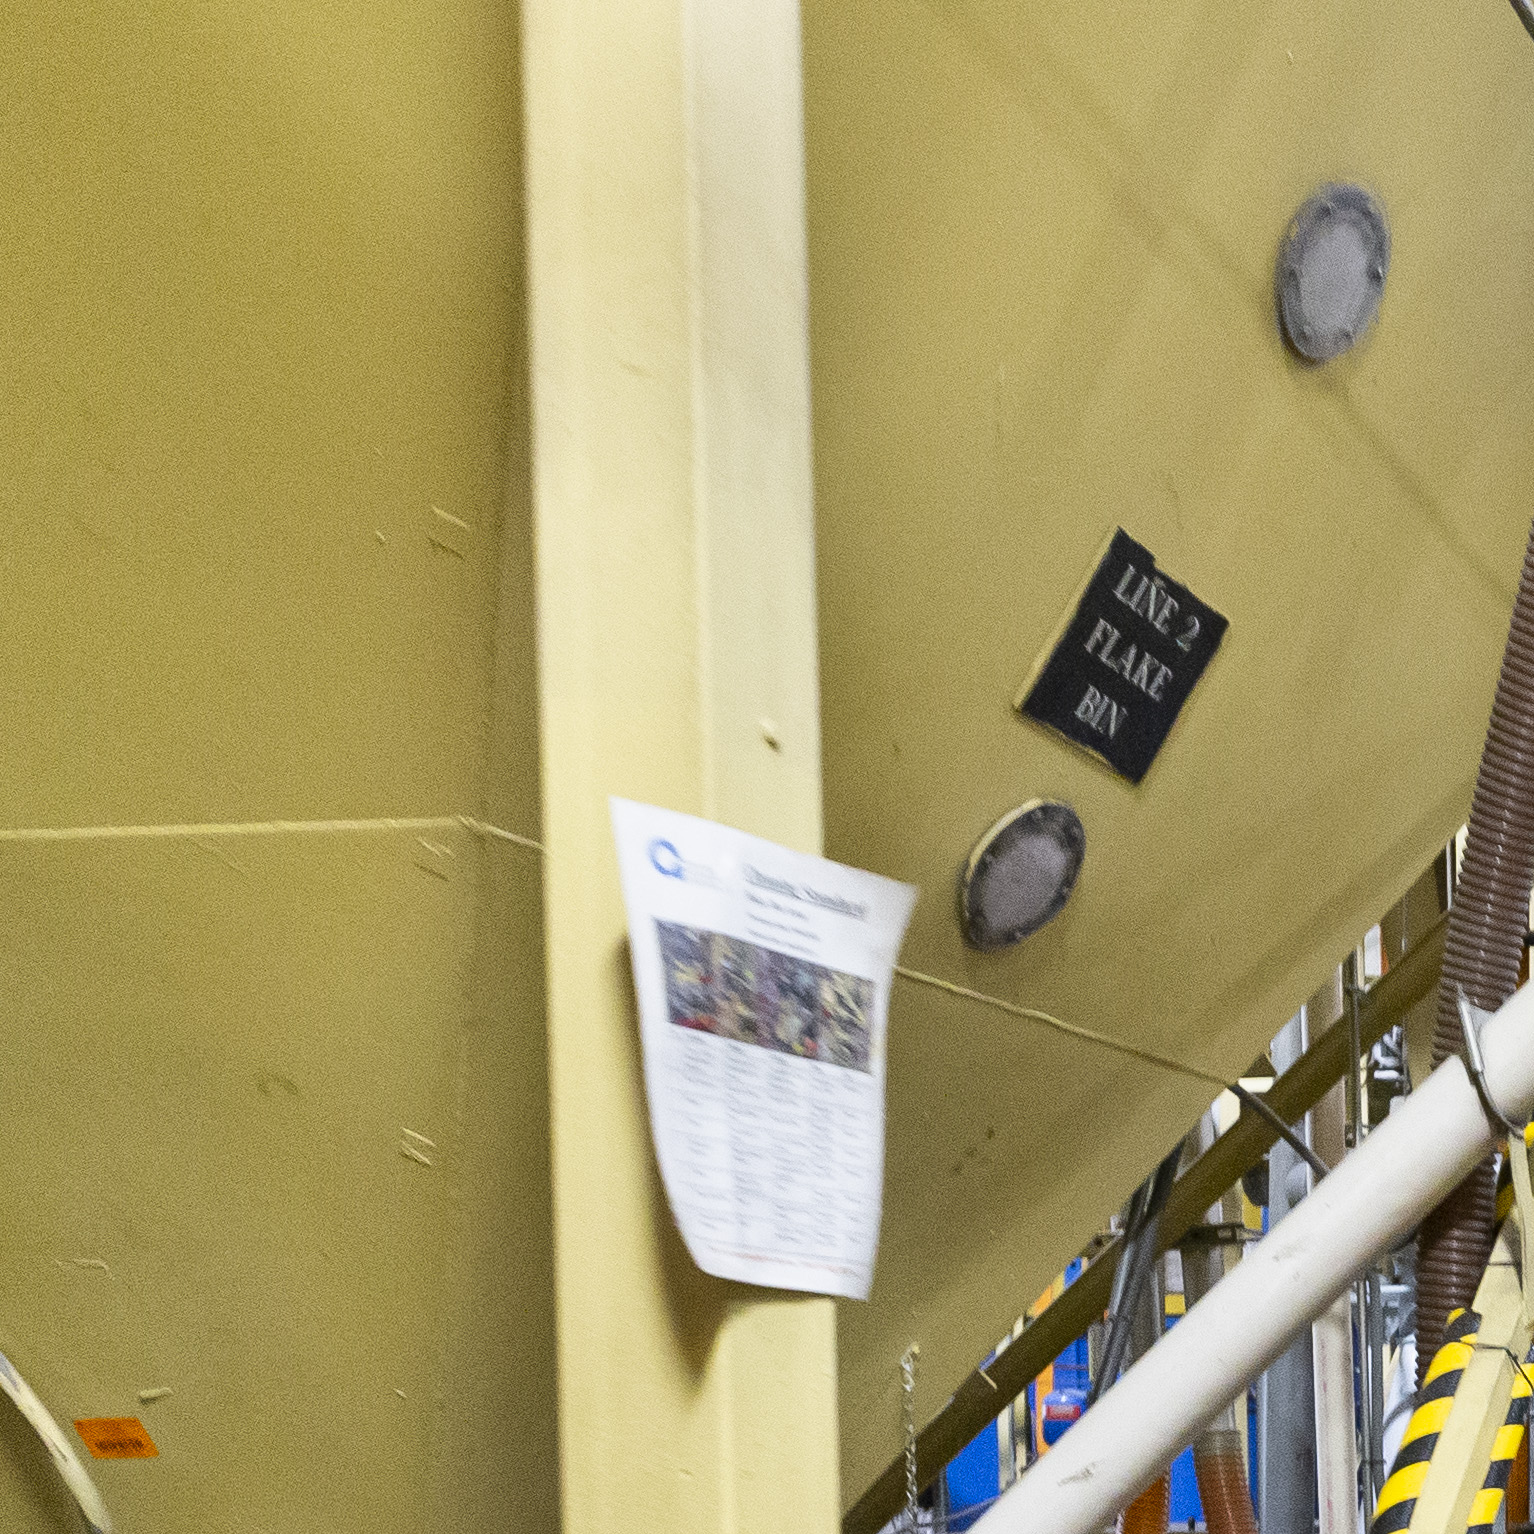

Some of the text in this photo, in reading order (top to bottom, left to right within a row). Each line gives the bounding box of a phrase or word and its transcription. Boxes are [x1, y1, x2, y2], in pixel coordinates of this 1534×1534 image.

[1112, 563, 1200, 653] LINE 2
[1083, 618, 1173, 702] FLAKE
[1074, 683, 1128, 739] BIN
